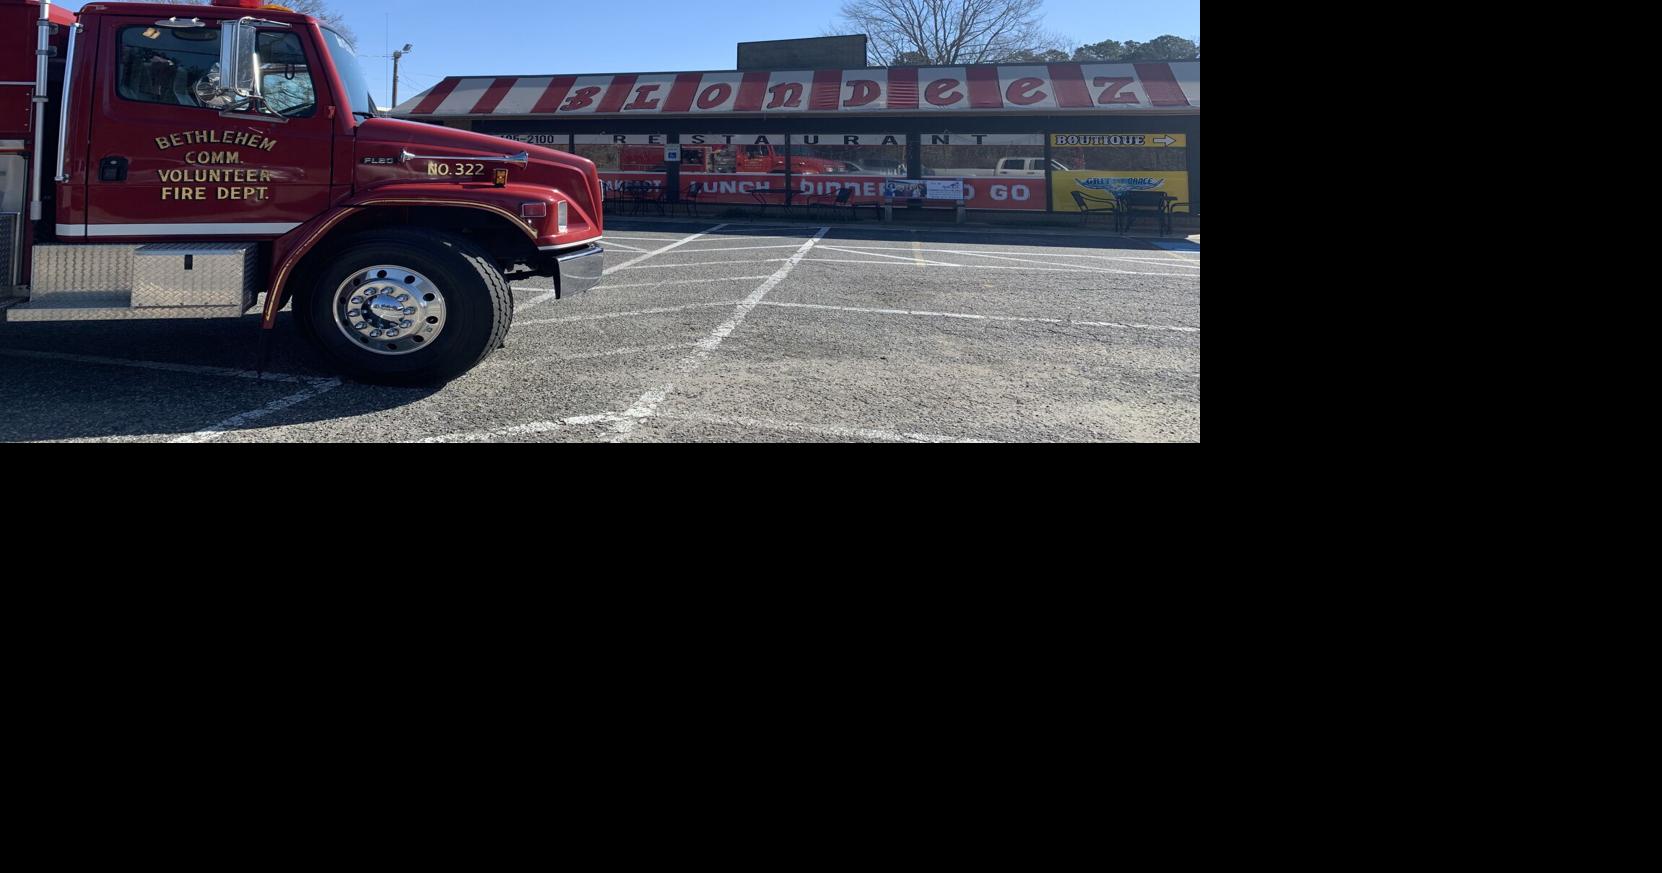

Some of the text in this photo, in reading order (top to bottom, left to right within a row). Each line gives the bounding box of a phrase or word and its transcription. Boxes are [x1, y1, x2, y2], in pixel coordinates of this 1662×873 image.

[155, 130, 277, 151] BETHLEHEM
[613, 134, 988, 145] RESTAURANT
[1055, 134, 1145, 146] BOUTIQUE
[185, 151, 244, 164] COMM.
[158, 169, 271, 182] VOLUNTEER
[161, 187, 270, 200] FIRE DEPT.
[990, 184, 1031, 200] GO
